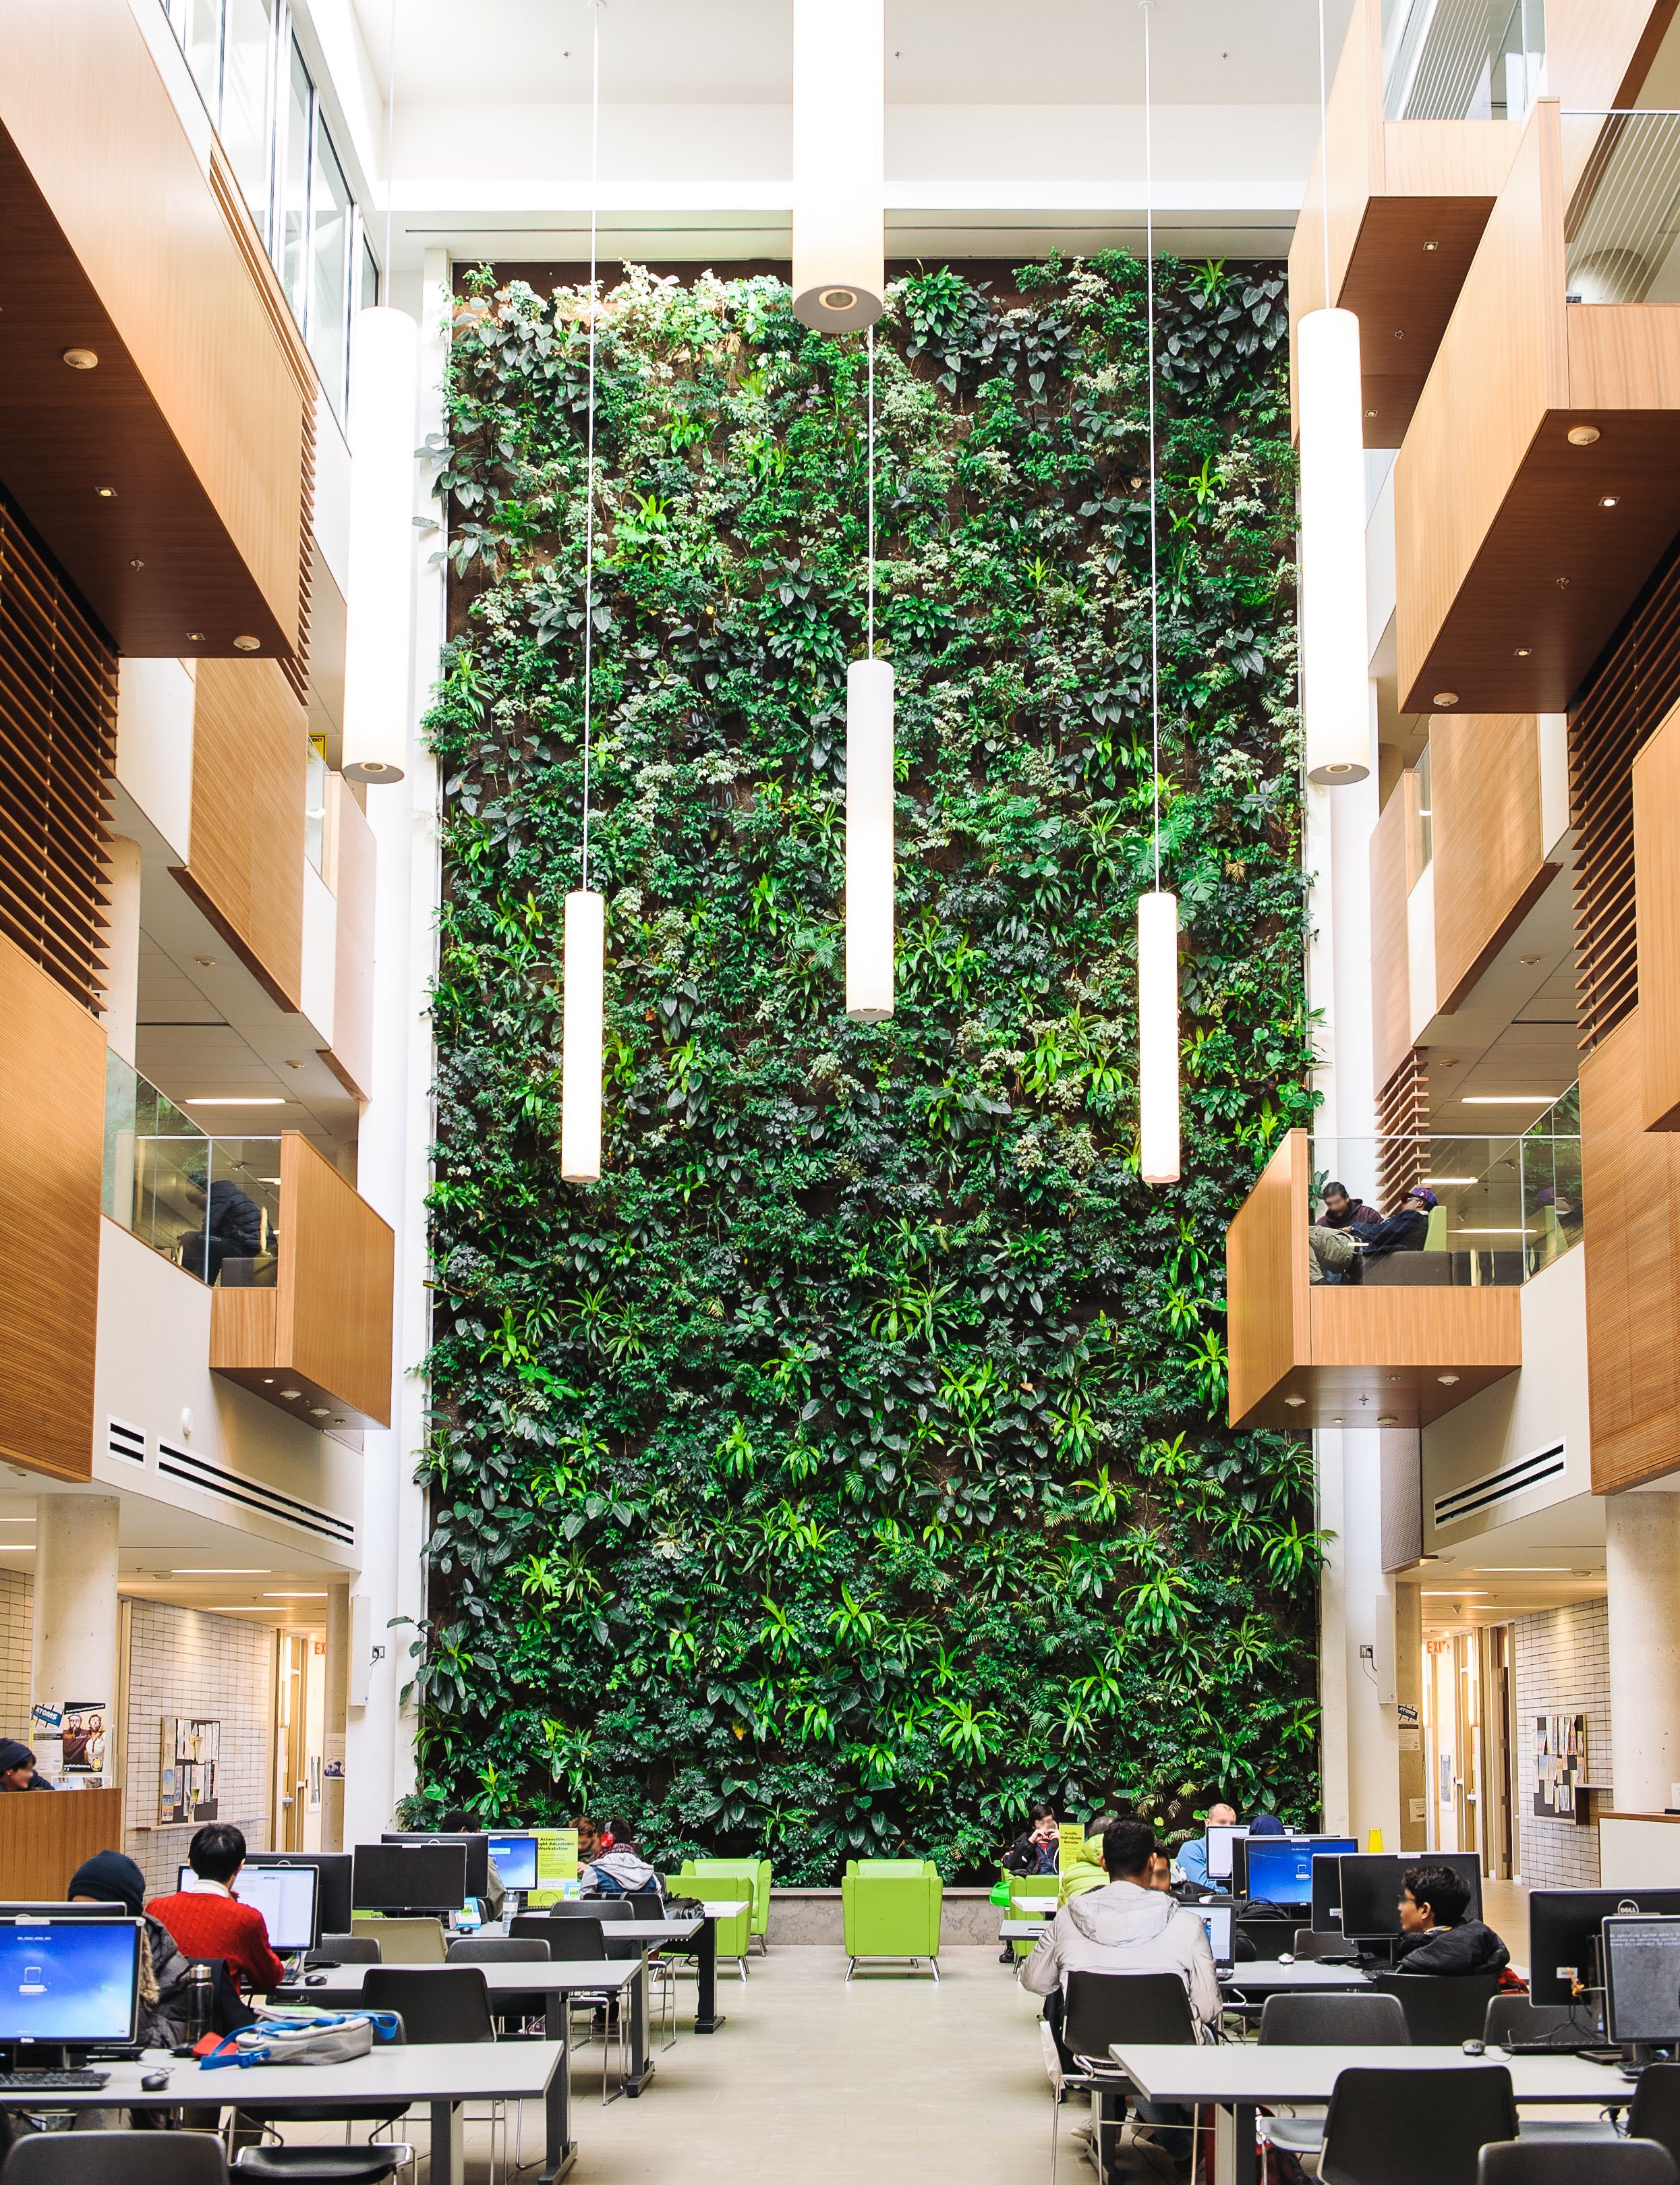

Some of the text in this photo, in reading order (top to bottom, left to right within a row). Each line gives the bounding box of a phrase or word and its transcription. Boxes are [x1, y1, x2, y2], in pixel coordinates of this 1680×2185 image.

[314, 1641, 326, 1655] EX
[1426, 1640, 1447, 1653] EXIT
[35, 1707, 58, 1720] ATOMS
[1399, 1707, 1416, 1716] ATOMS
